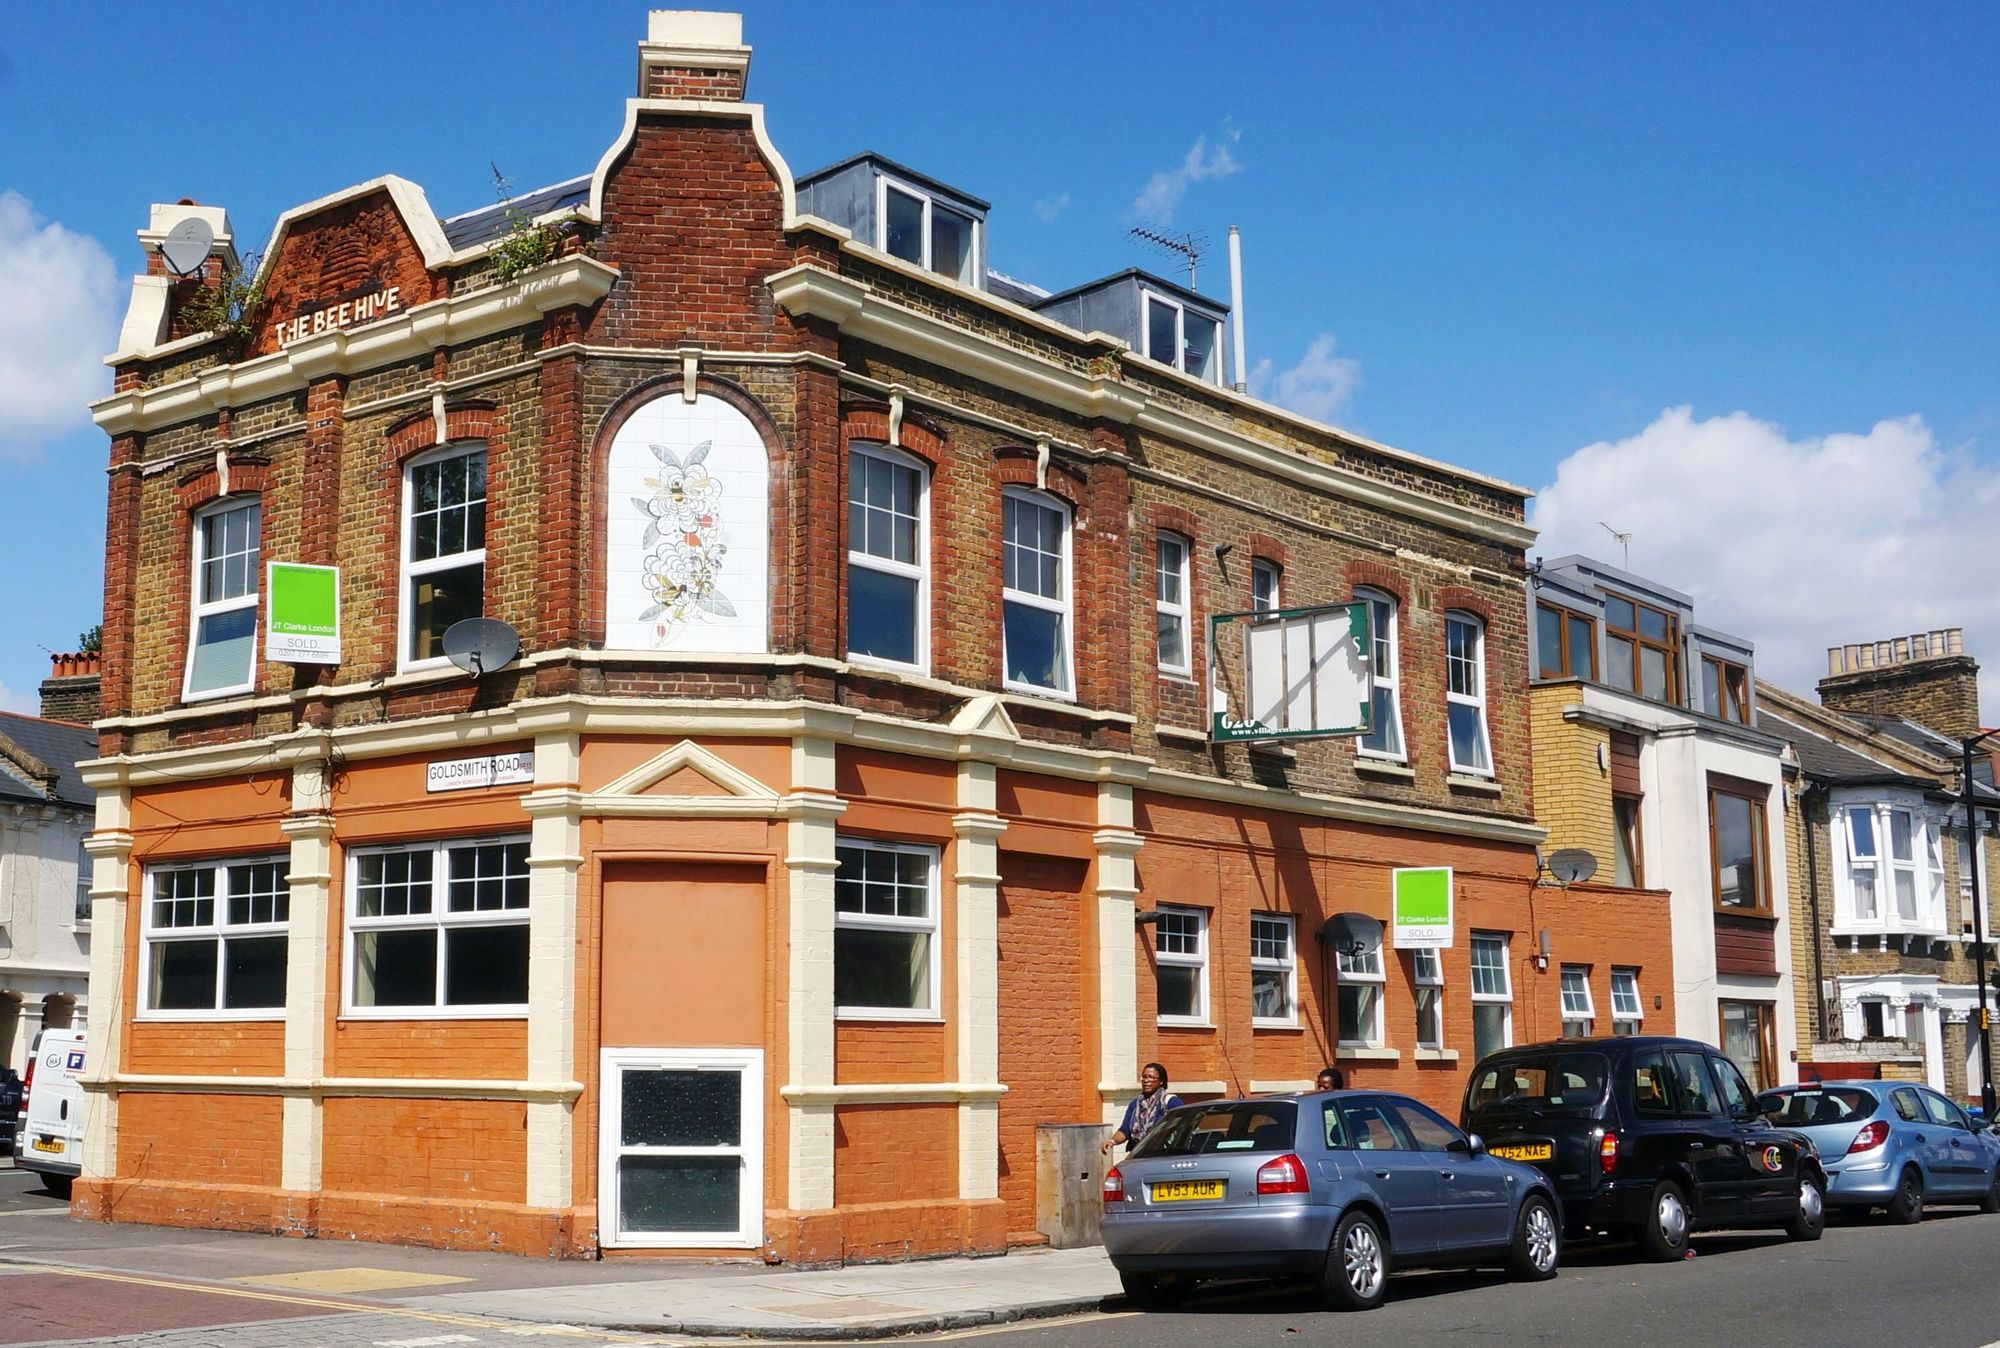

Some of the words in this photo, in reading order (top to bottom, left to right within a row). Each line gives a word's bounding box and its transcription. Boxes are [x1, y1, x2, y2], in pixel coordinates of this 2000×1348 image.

[275, 315, 311, 346] THE
[313, 302, 351, 334] BEE
[353, 286, 400, 321] HIVE
[272, 622, 282, 630] JT
[283, 622, 308, 632] Clarke
[308, 624, 336, 633] London
[429, 761, 488, 780] GOLDSMITH
[490, 757, 520, 774] ROAD
[1525, 1147, 1546, 1156] NAE
[1158, 1183, 1188, 1198] LV53
[1192, 1182, 1216, 1196] AUR
